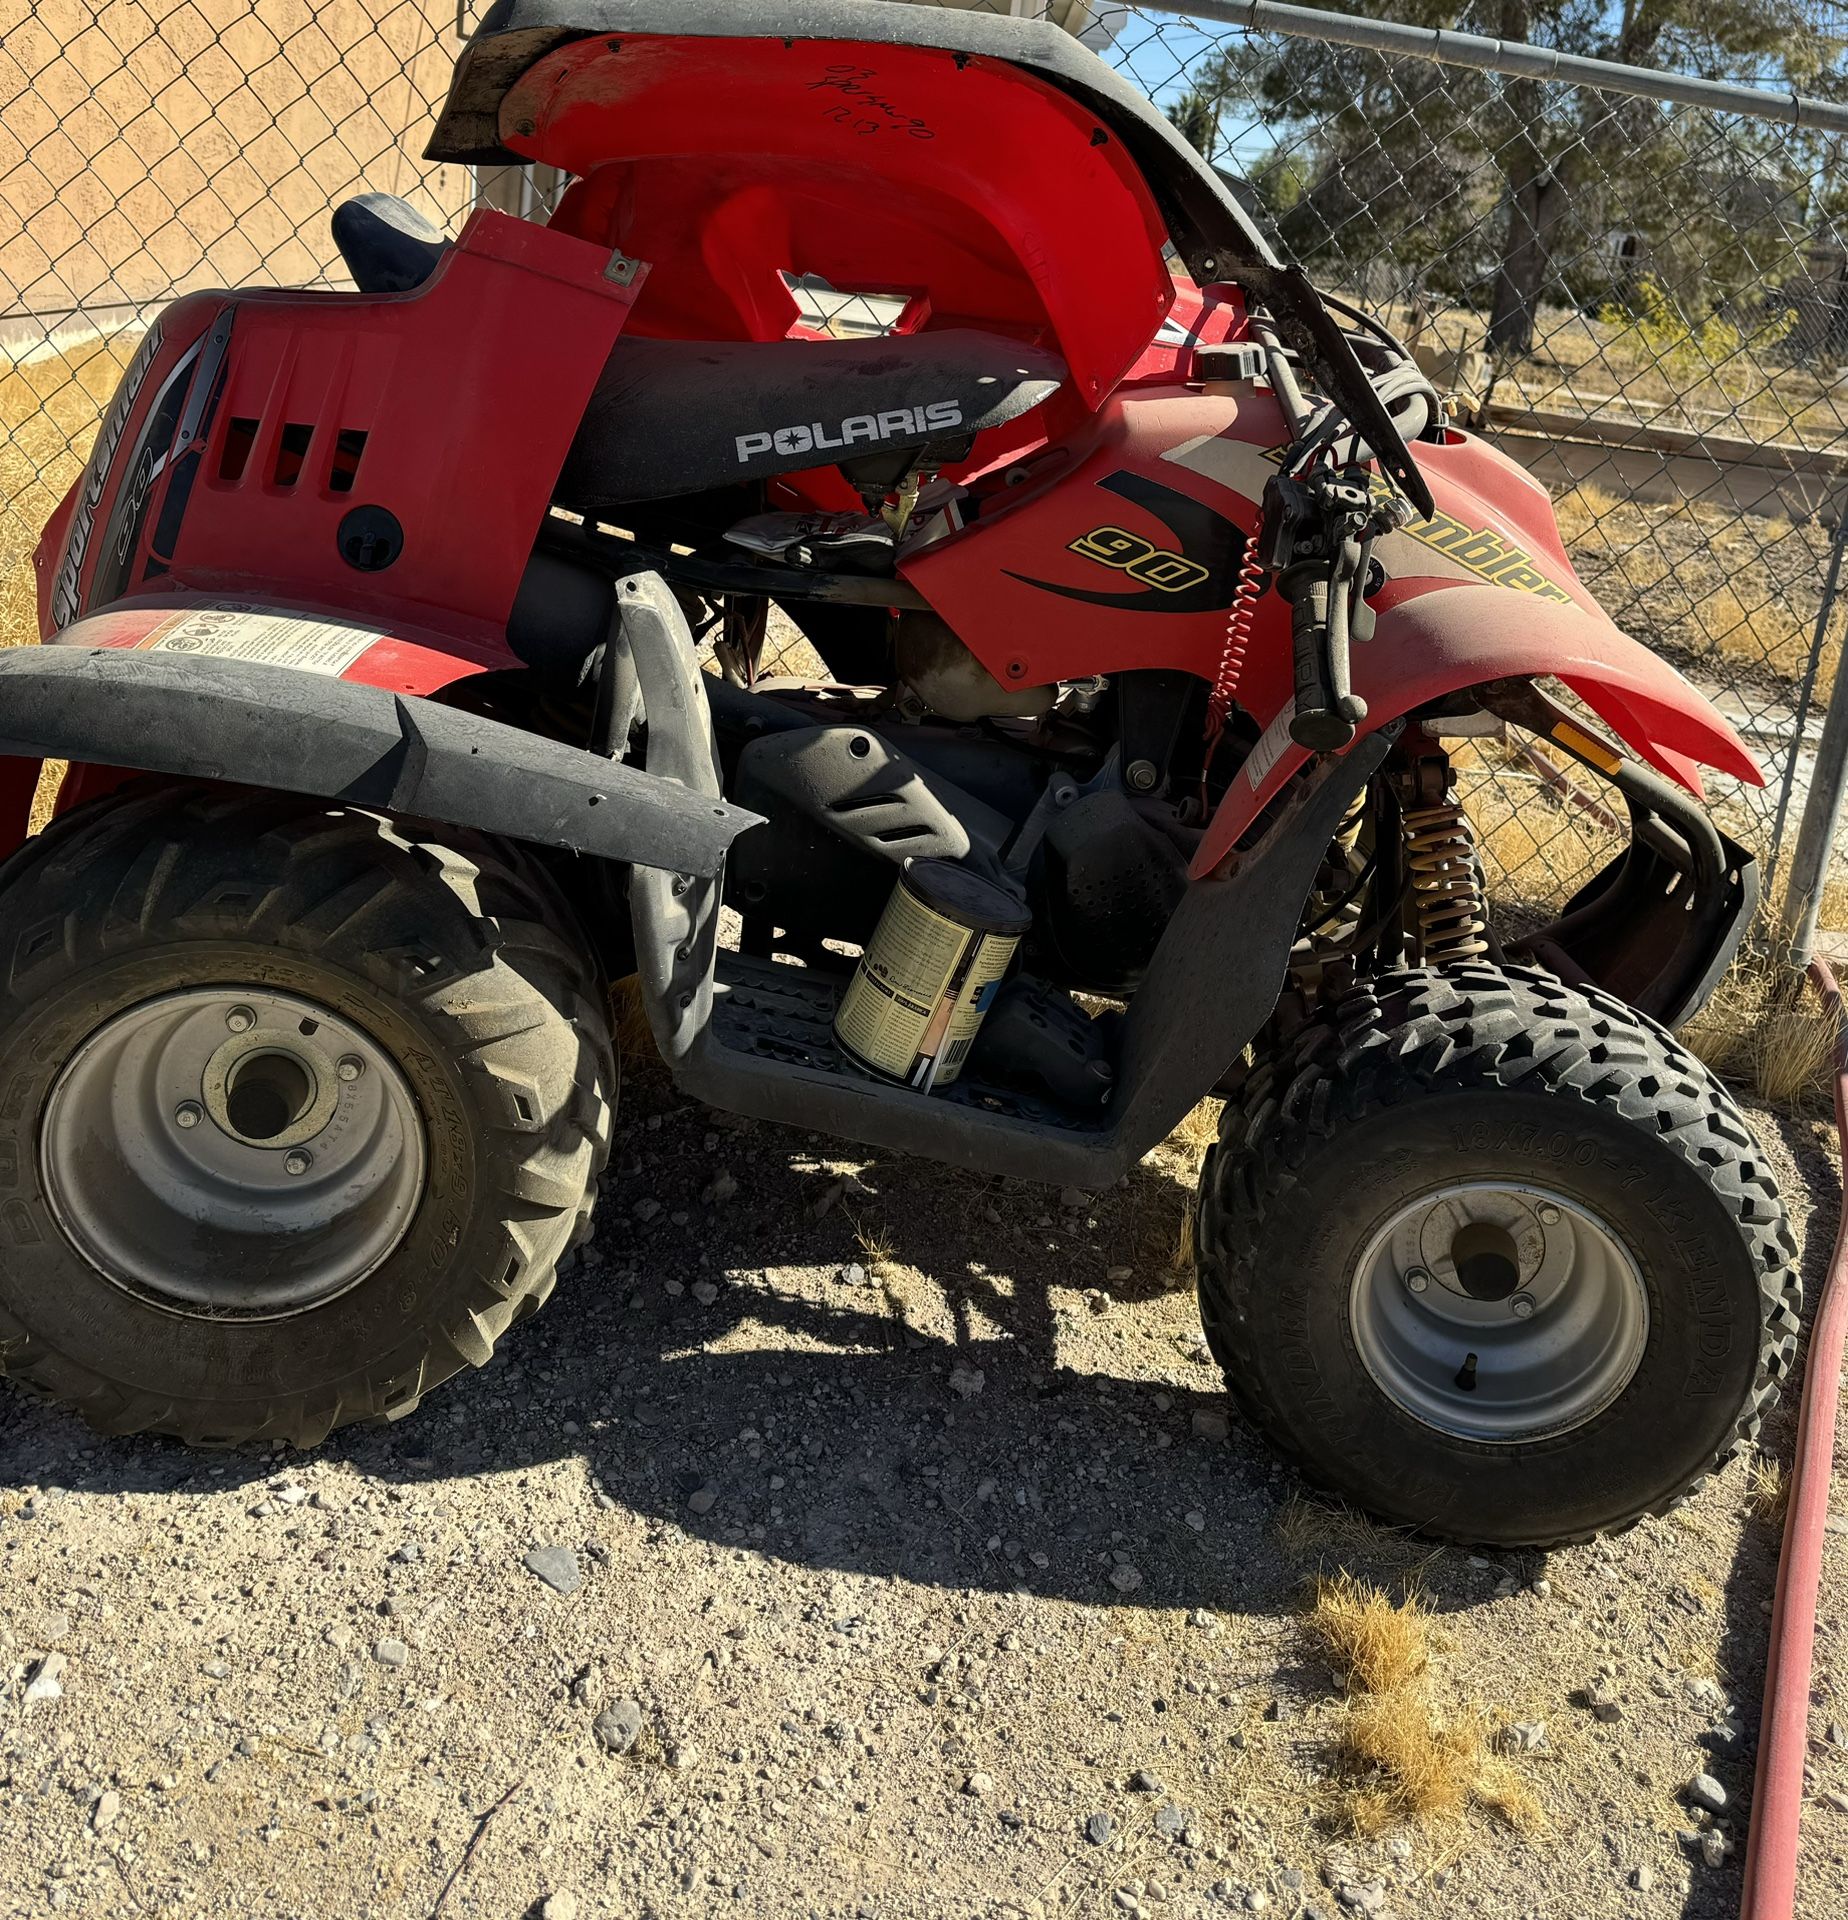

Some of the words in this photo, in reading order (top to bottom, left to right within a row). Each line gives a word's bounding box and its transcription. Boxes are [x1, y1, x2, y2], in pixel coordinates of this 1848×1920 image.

[735, 399, 963, 463] POLARIS
[1067, 526, 1211, 593] 90
[1258, 444, 1573, 605] mbler
[1642, 1185, 1733, 1398] KENDA
